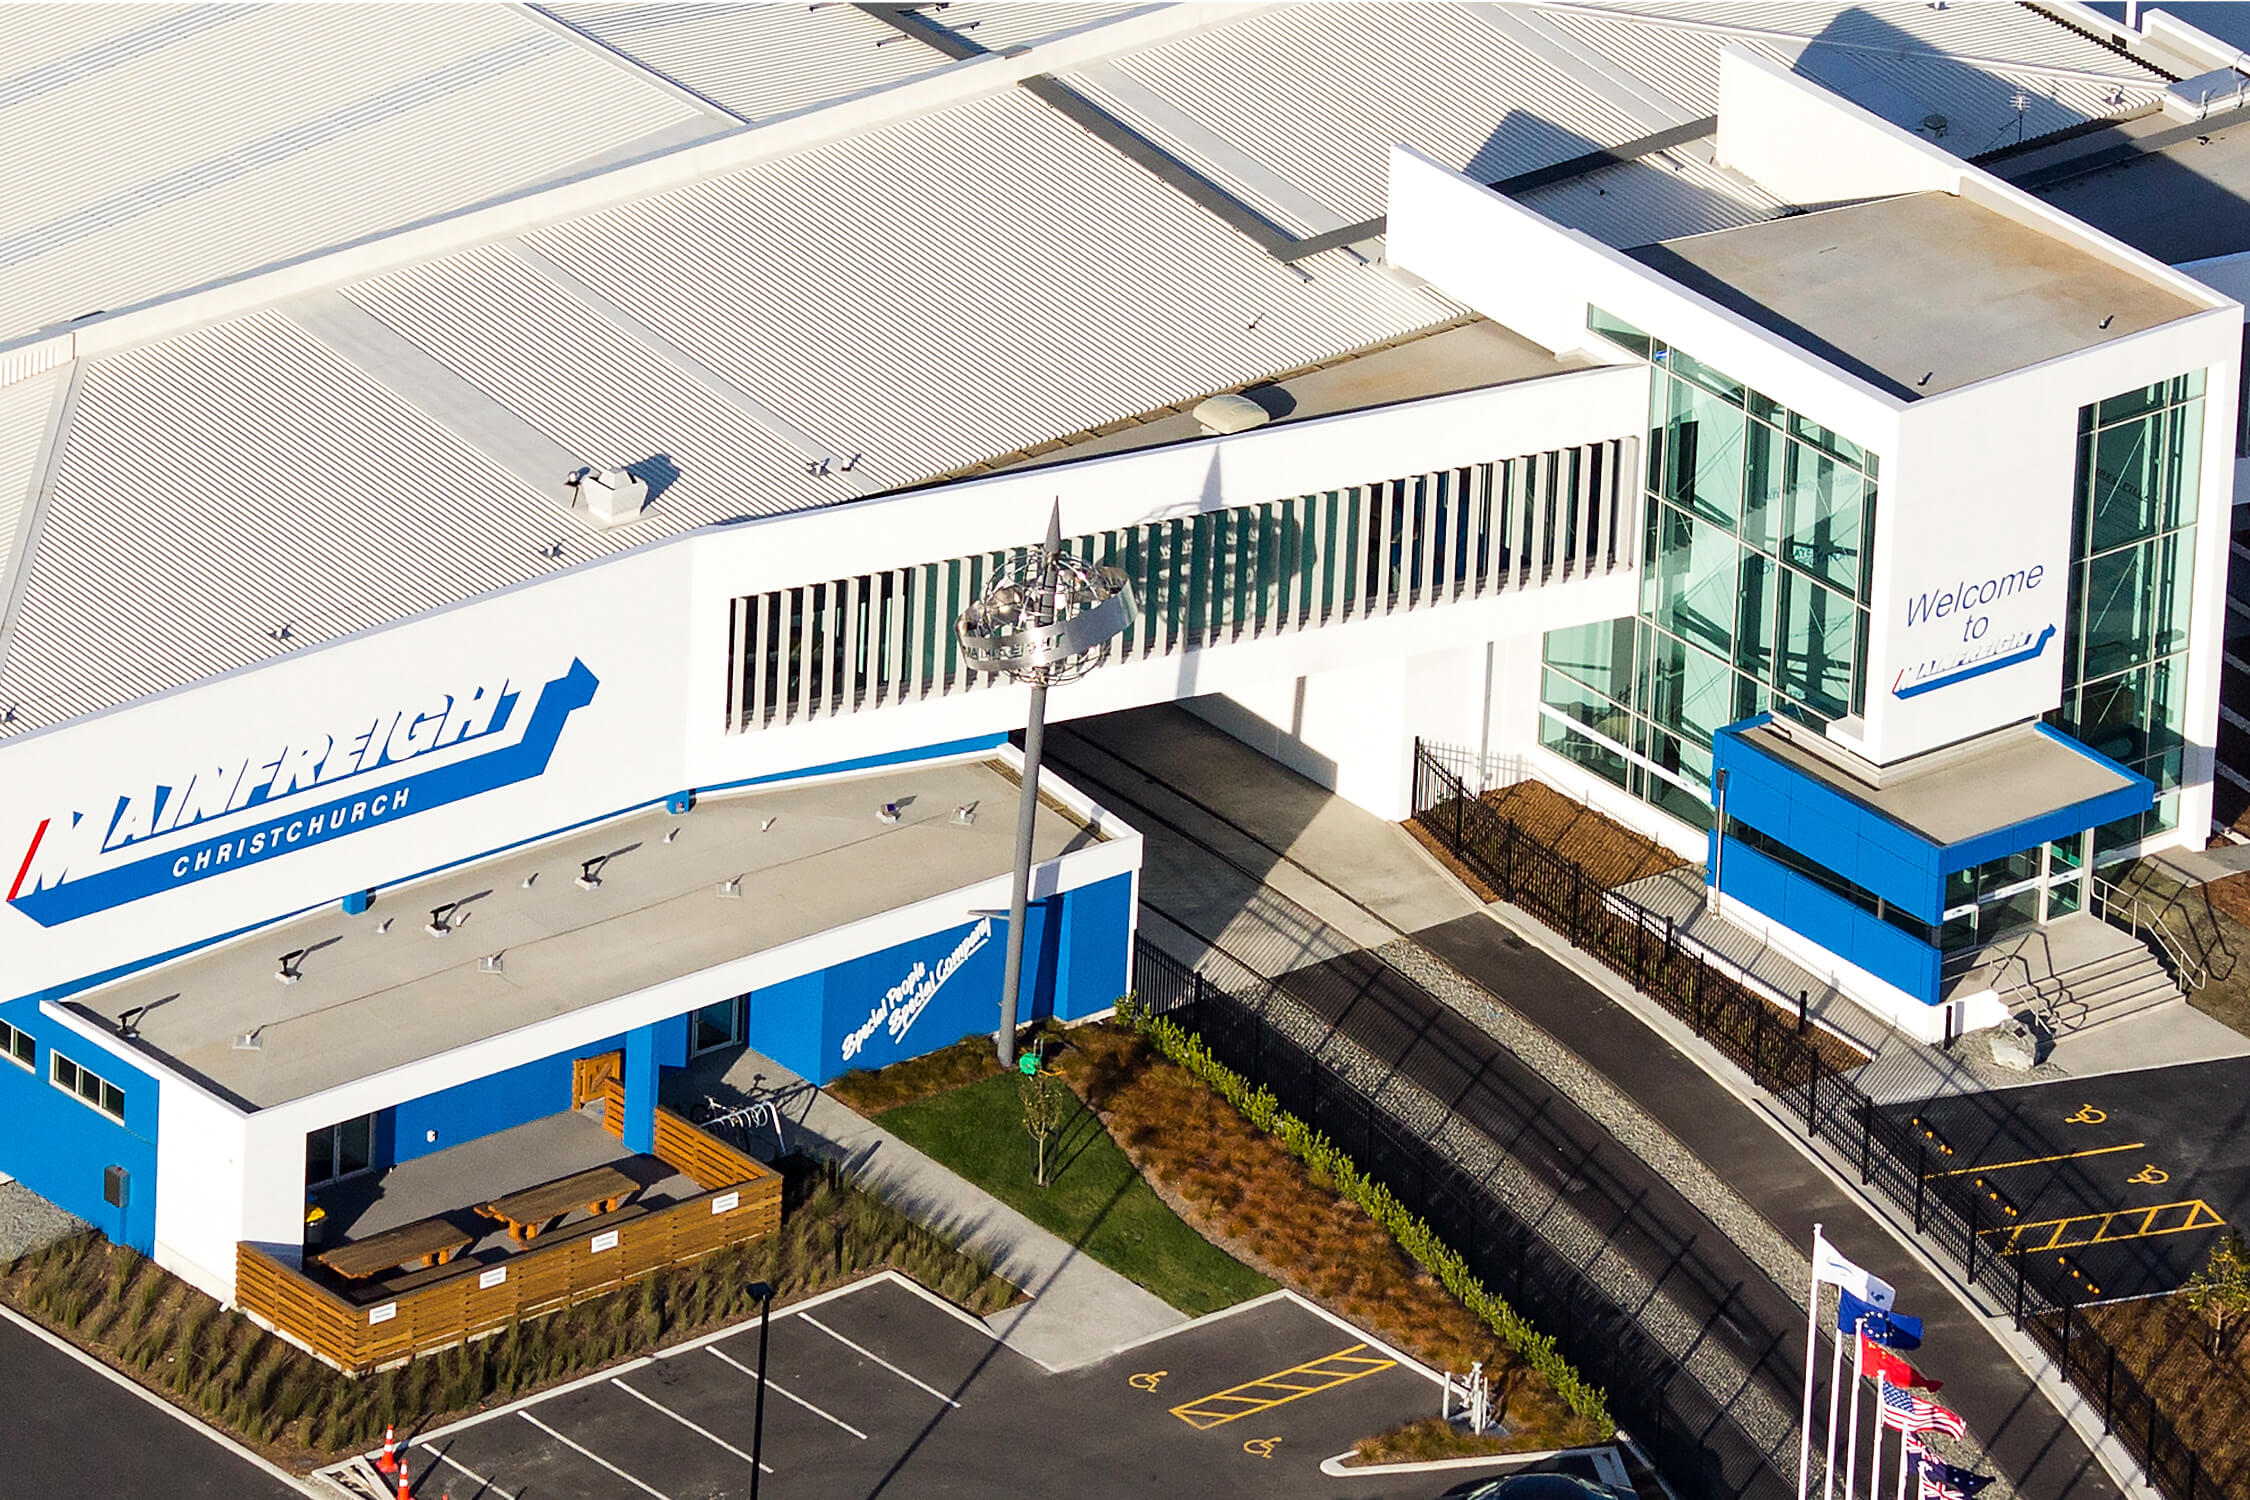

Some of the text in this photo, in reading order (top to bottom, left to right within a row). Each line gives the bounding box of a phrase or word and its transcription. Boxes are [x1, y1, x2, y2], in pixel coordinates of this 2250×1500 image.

[1907, 564, 2044, 627] Welcome
[1963, 614, 1989, 642] to
[6, 666, 548, 902] MAINFREIGHT
[172, 788, 411, 878] CHRISTCHURCH
[842, 961, 926, 1061] Special People
[888, 916, 992, 1036] Special Company
